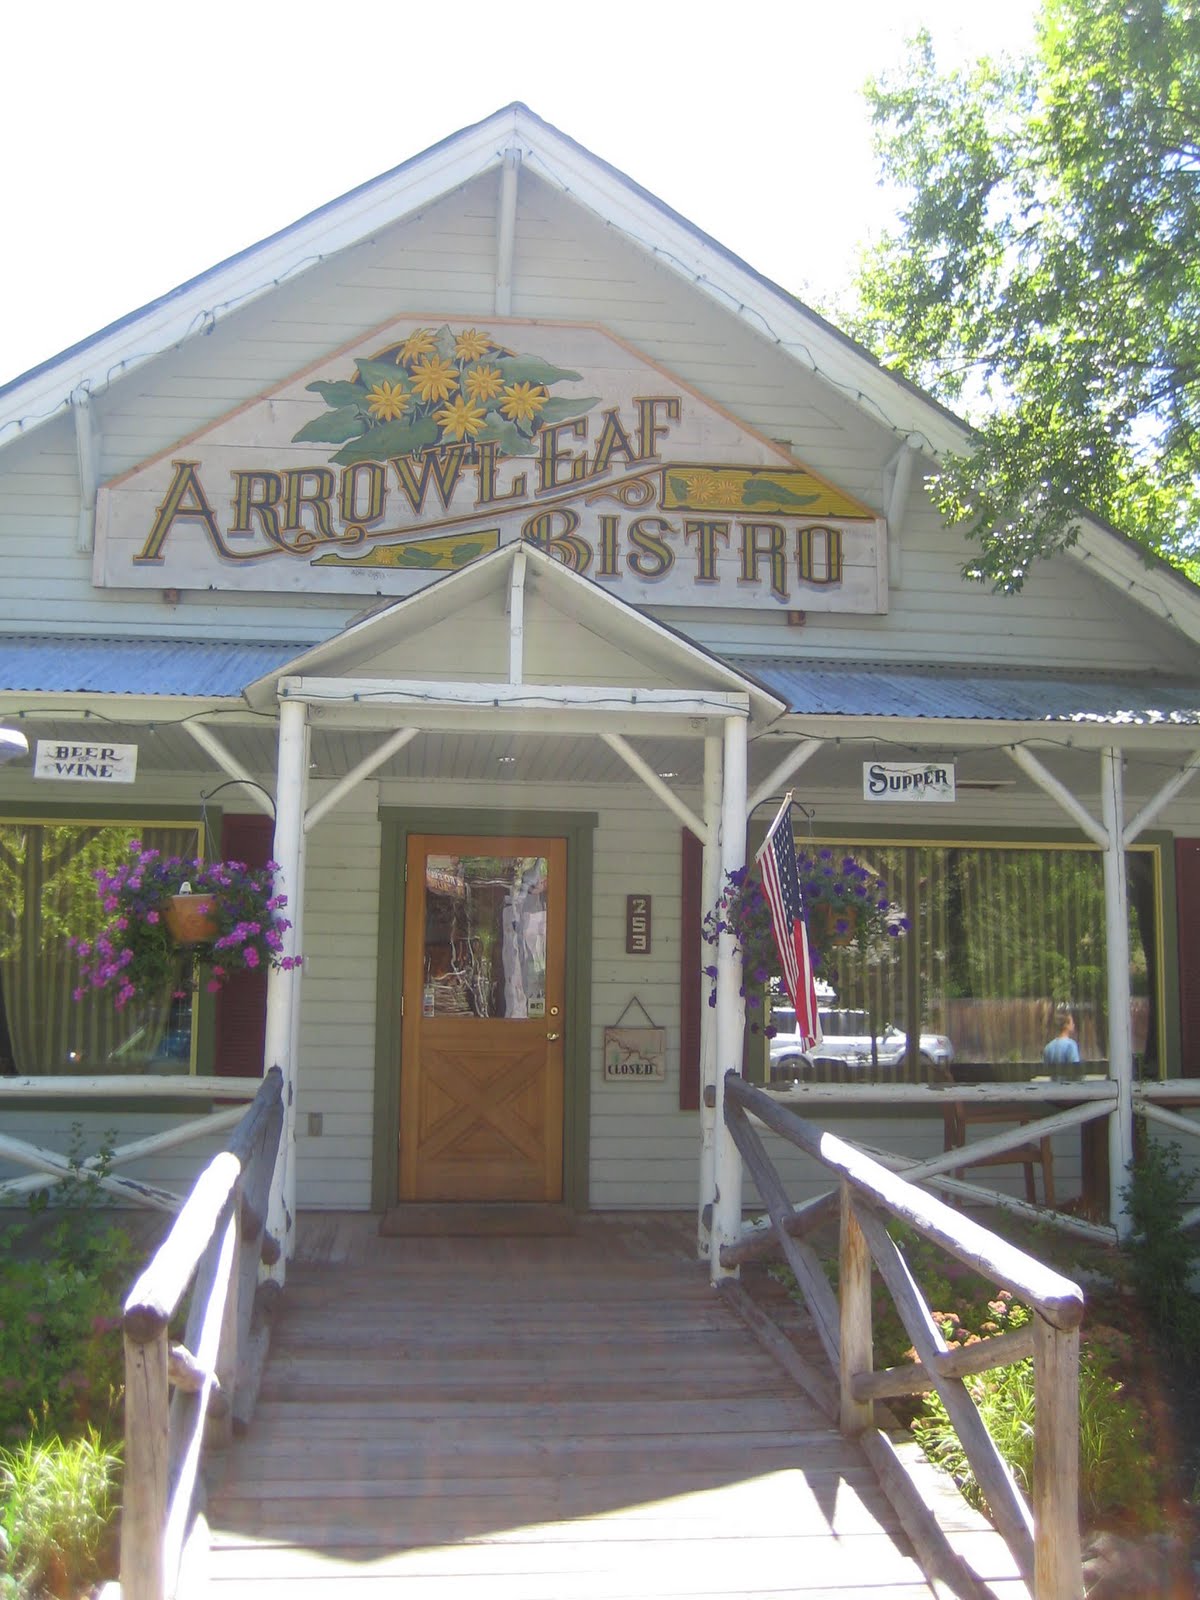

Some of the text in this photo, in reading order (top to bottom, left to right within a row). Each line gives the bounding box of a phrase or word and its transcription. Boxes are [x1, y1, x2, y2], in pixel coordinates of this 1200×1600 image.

[132, 395, 682, 566] ARROWLEAF
[521, 506, 844, 603] BISTRO
[55, 746, 123, 761] BEER
[55, 762, 114, 778] WINE
[869, 765, 950, 794] SUPPER
[607, 1062, 654, 1076] CLOSED
